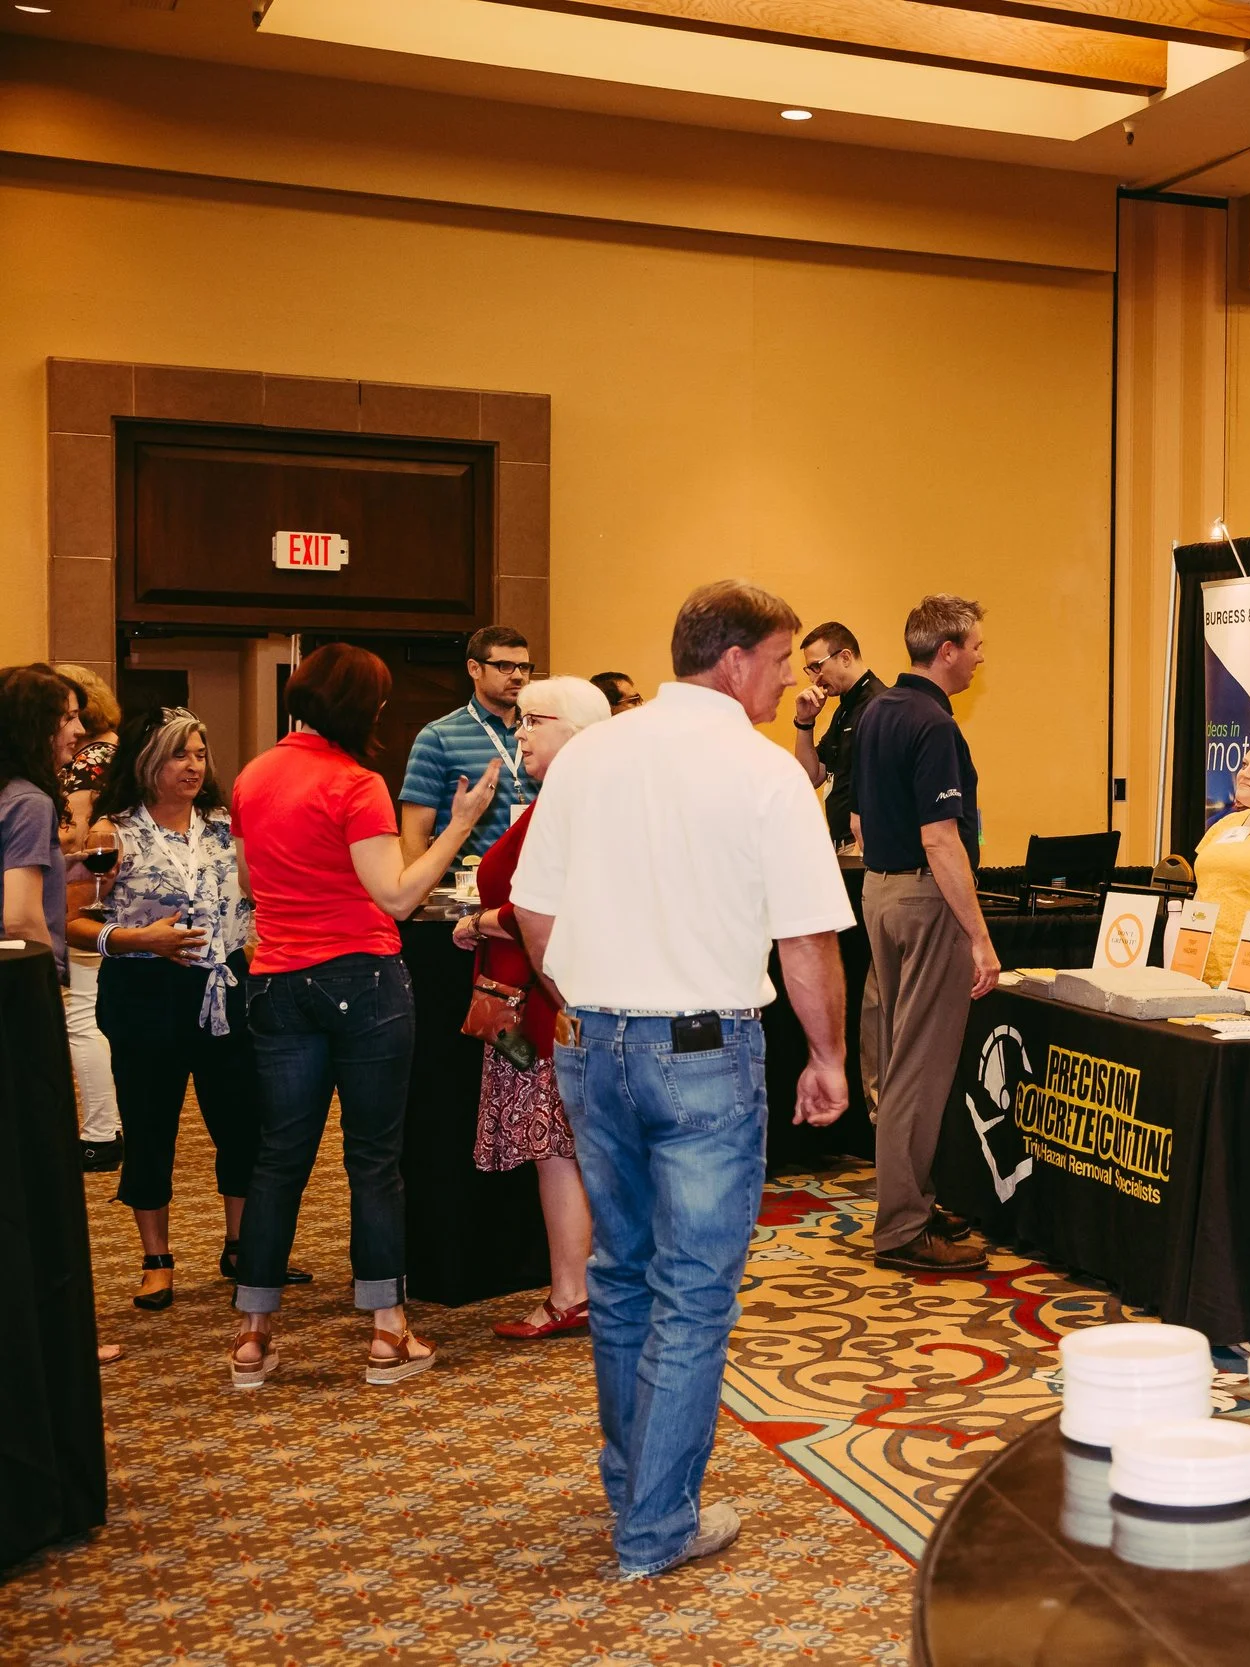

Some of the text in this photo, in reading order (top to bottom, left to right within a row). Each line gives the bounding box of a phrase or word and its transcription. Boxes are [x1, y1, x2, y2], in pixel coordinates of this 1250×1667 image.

[289, 534, 332, 566] EXIT
[1205, 608, 1246, 626] BURGESS
[1230, 720, 1241, 737] in
[1046, 1045, 1140, 1120] PRECISION
[1015, 1081, 1096, 1155] CONCRETE
[1069, 1154, 1112, 1185] Removal
[1115, 1168, 1161, 1204] Specialists
